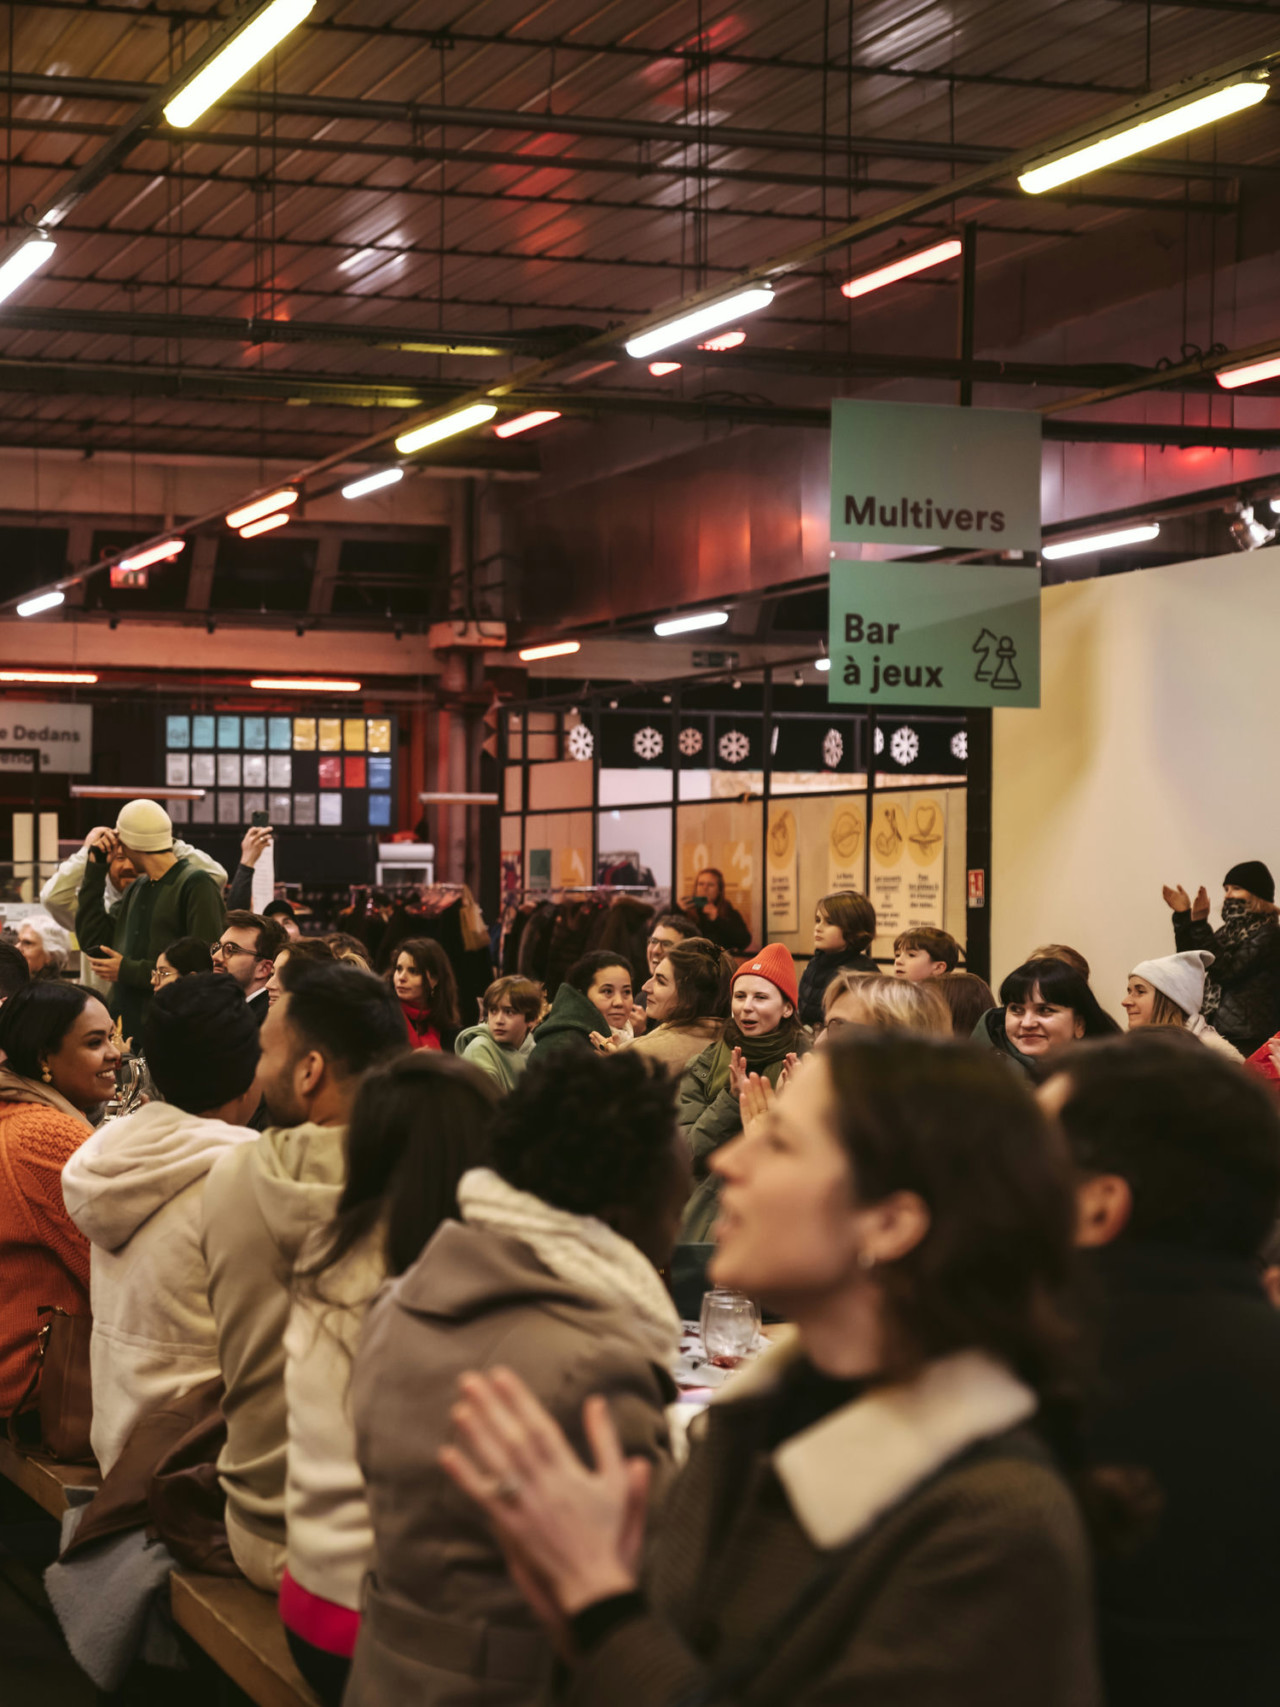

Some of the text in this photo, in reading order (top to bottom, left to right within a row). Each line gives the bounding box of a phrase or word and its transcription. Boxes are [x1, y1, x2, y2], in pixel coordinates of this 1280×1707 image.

[844, 495, 1006, 533] Multivers
[844, 613, 900, 644] Bar
[843, 656, 944, 694] à jeux
[13, 724, 81, 743] Dedans
